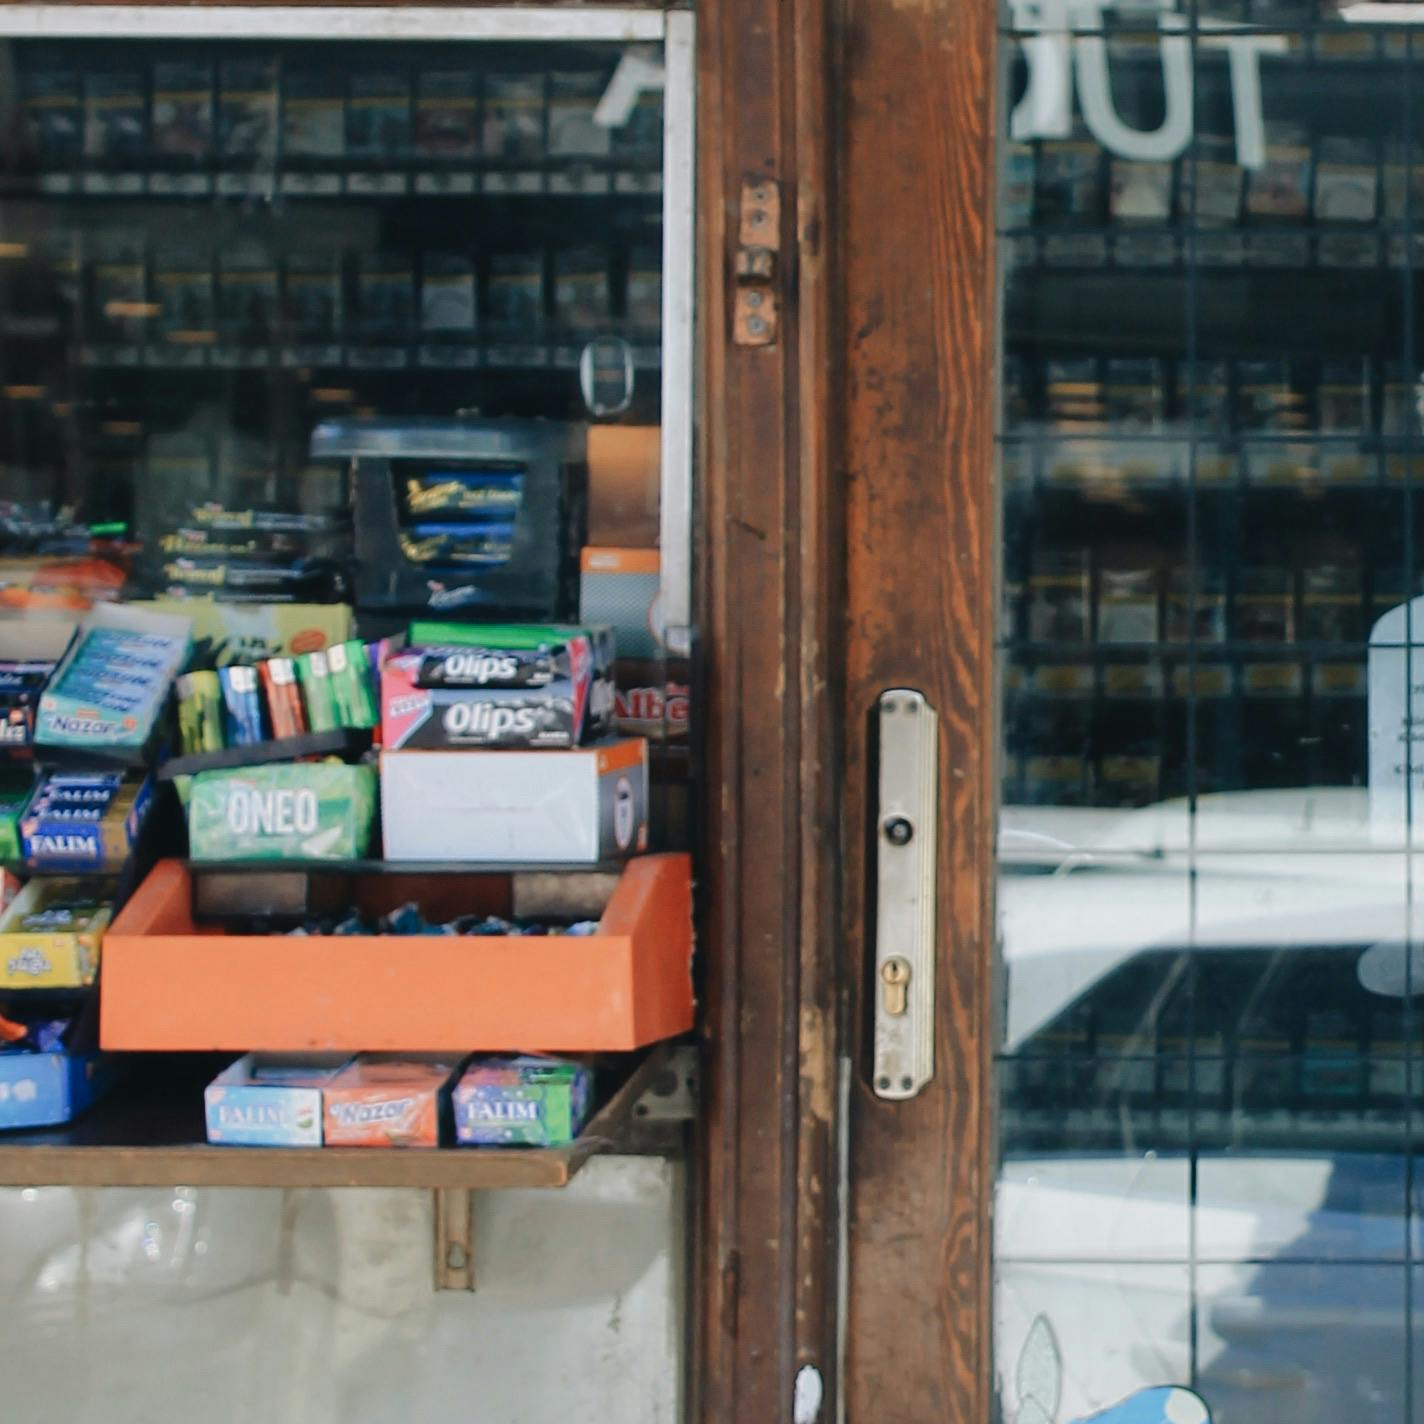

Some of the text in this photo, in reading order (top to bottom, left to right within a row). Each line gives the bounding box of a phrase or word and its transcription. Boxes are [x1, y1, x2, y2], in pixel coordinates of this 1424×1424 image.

[444, 654, 519, 684] Olips
[445, 701, 535, 737] Olips
[30, 833, 97, 854] FALIM
[466, 1101, 538, 1121] FALIM
